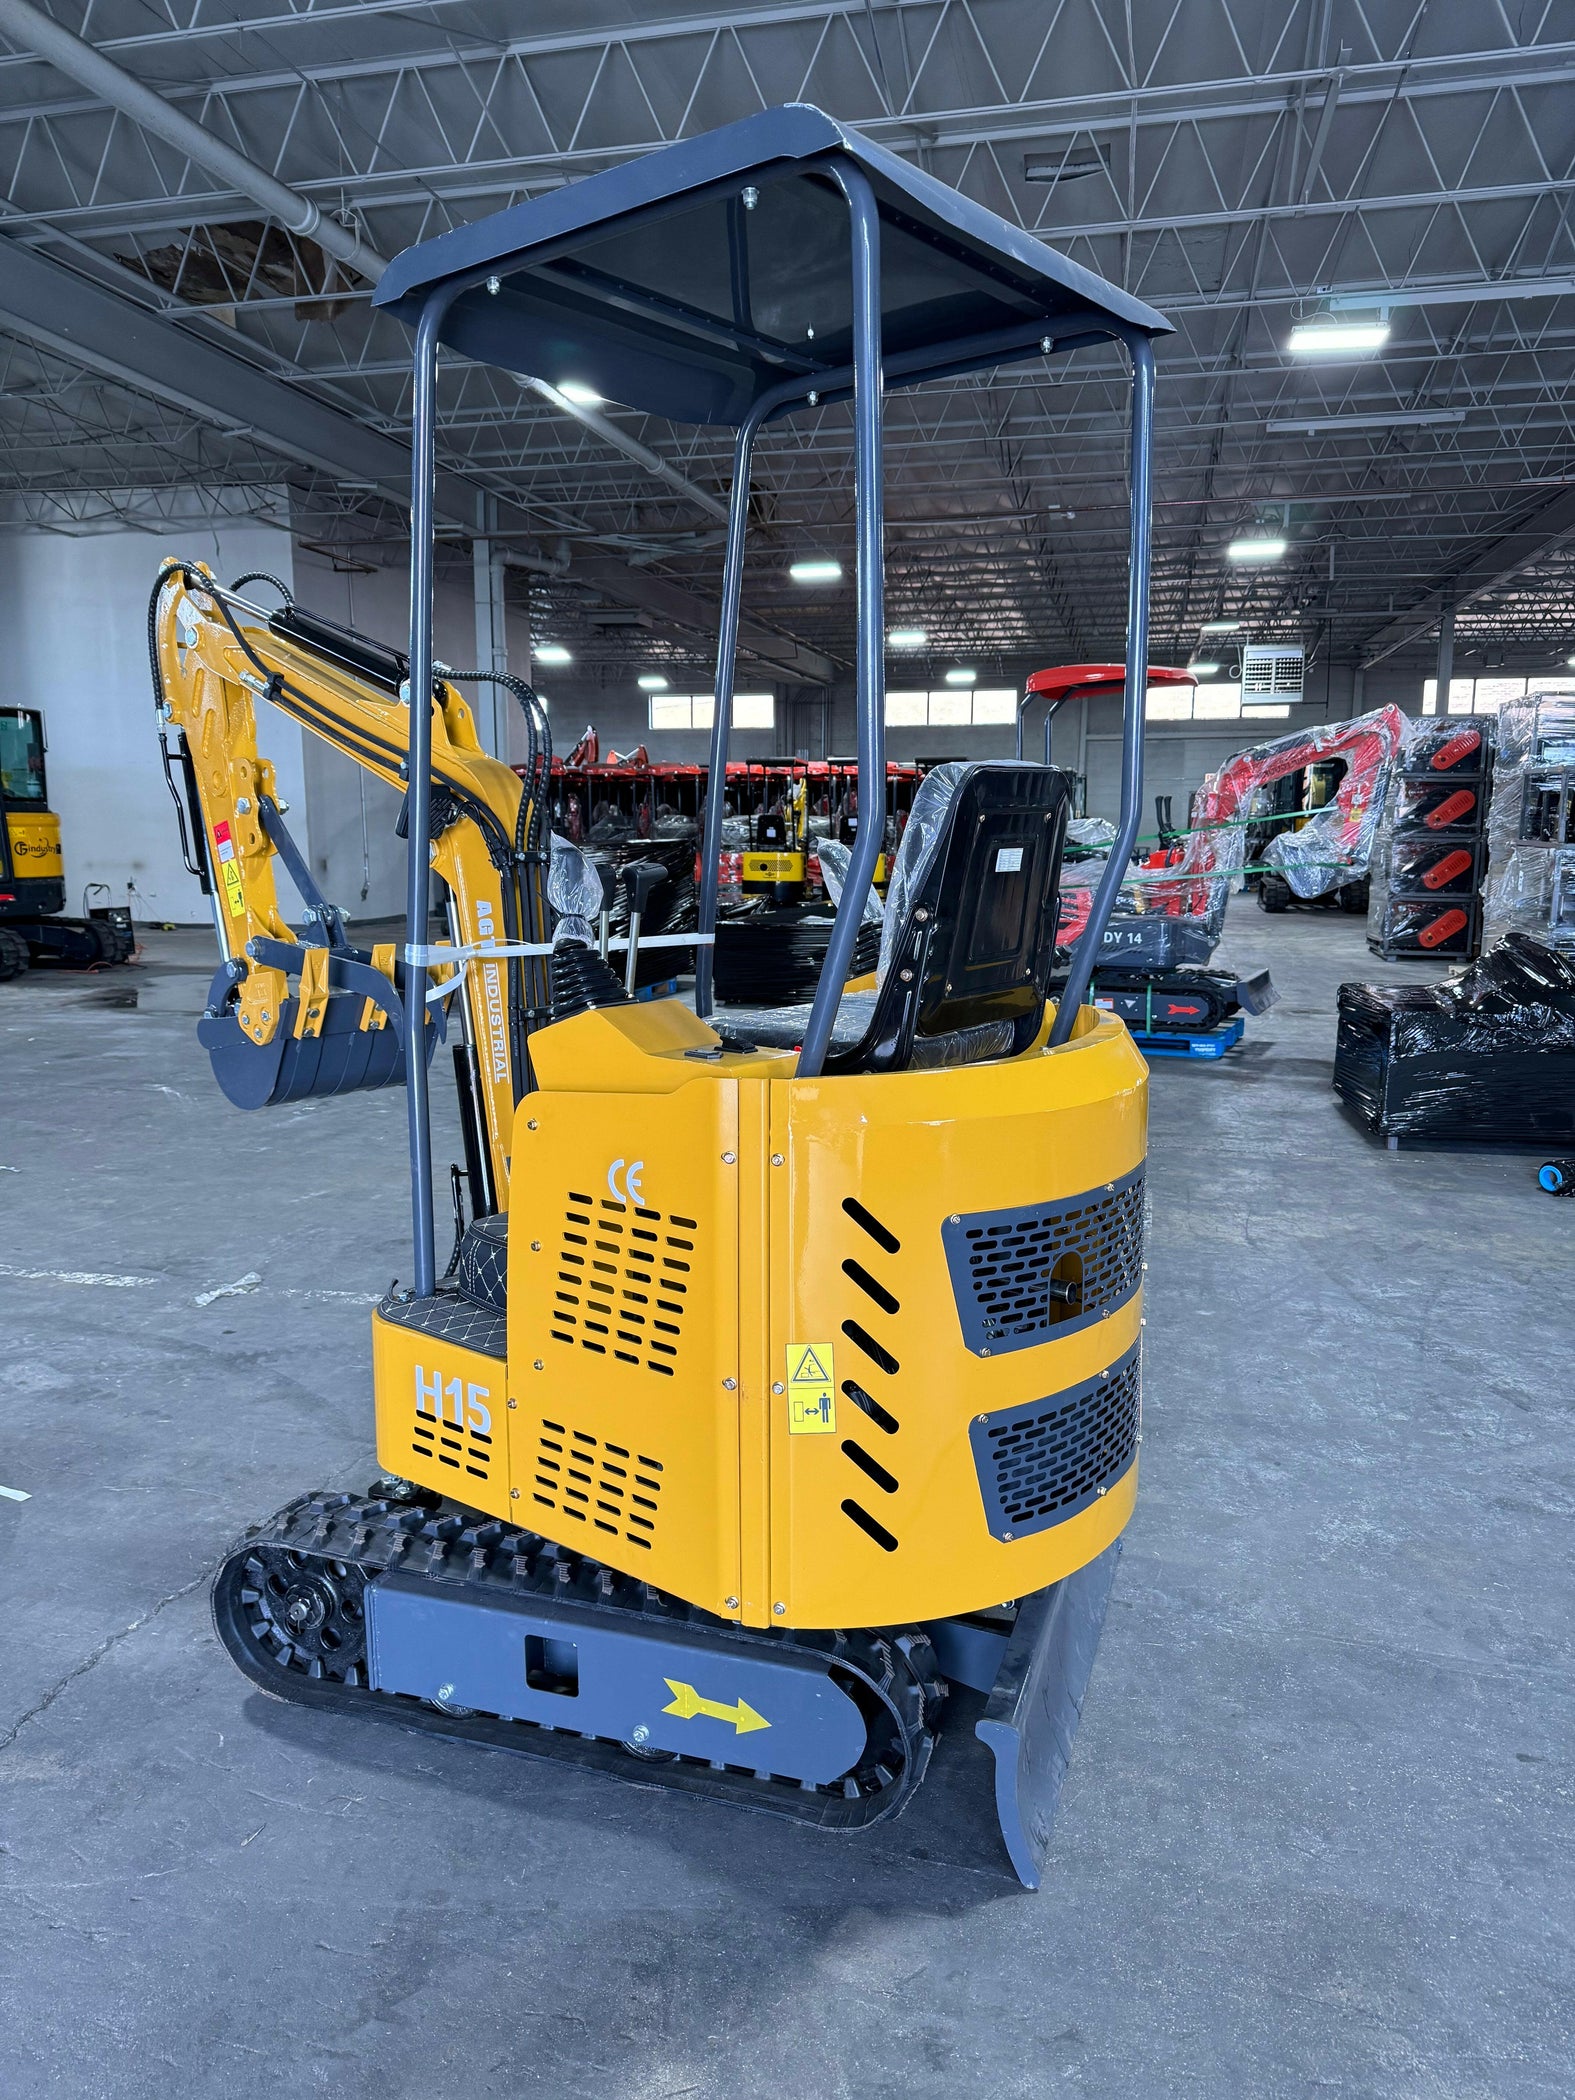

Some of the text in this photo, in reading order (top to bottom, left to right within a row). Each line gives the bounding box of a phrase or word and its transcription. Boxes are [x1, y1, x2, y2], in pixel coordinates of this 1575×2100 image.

[1127, 932, 1142, 944] 14
[485, 963, 508, 1084] INDUSTRIAL
[607, 1158, 645, 1206] CE
[414, 1364, 491, 1435] H15
